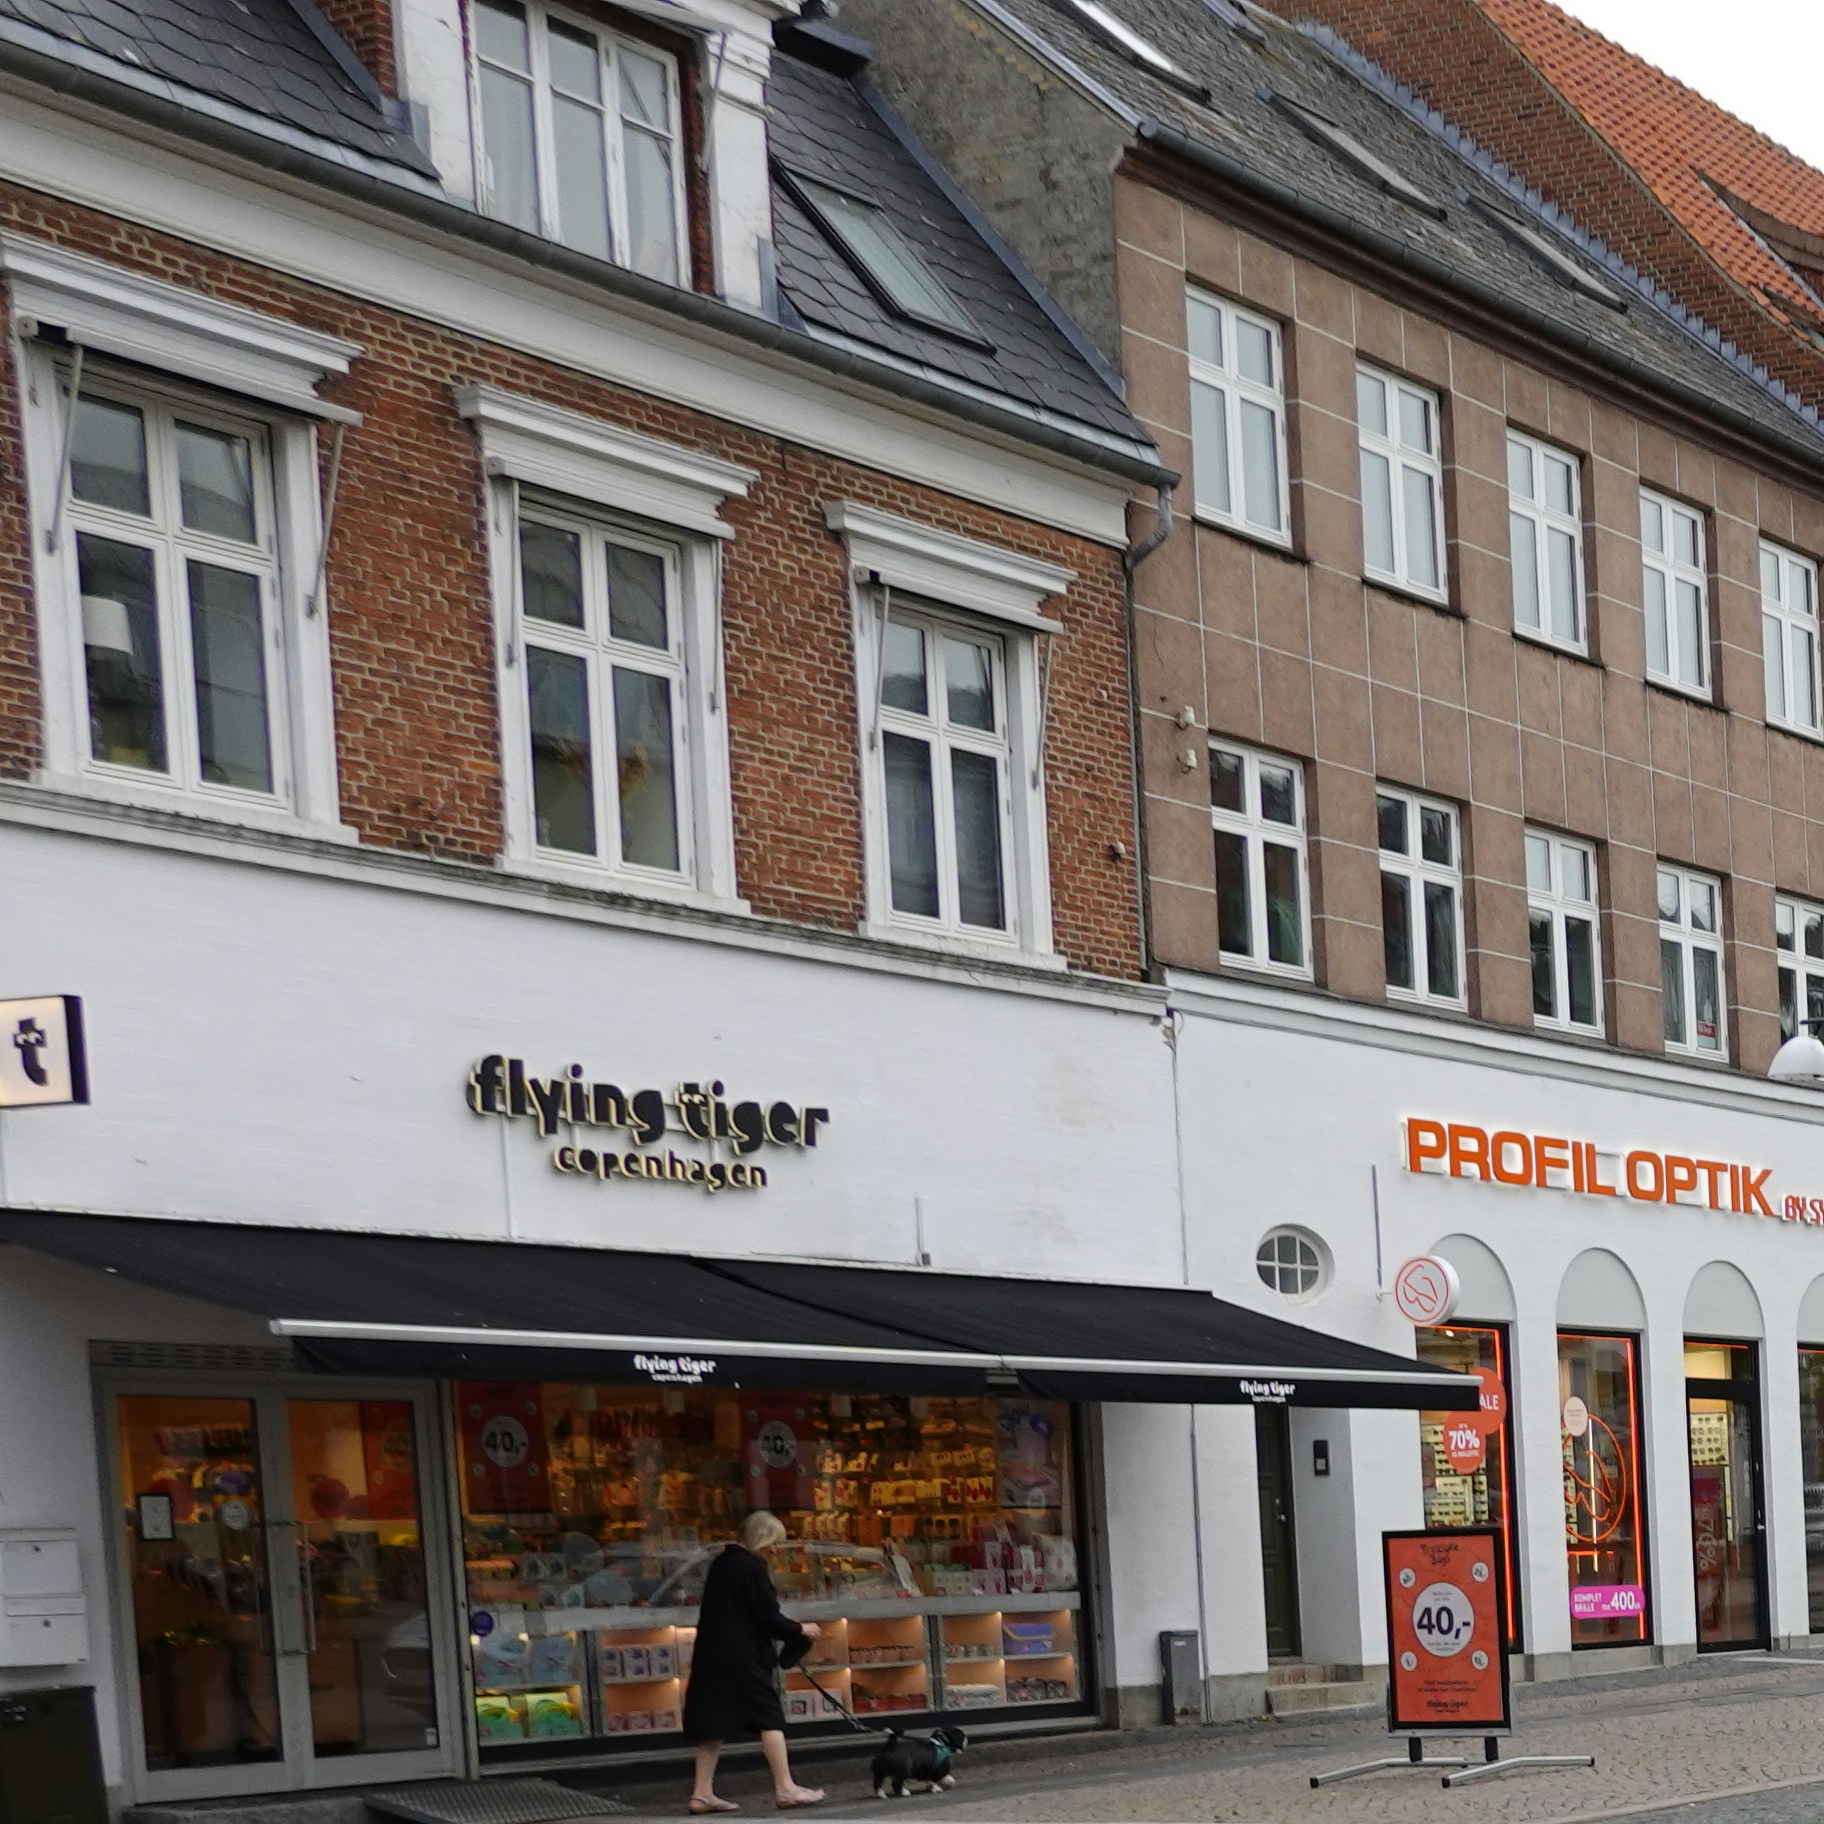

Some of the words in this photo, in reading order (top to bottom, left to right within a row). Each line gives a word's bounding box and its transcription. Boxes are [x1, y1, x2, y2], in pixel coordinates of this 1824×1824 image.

[467, 1054, 666, 1146] flying
[674, 1079, 830, 1156] tiger
[553, 1146, 768, 1192] copenhagen
[1407, 1117, 1617, 1196] PROFIL
[1626, 1150, 1774, 1216] OPTIK
[1479, 1393, 1500, 1410] ALE
[1448, 1428, 1481, 1450] 70%
[1611, 1590, 1635, 1610] 400
[1417, 1606, 1471, 1640] 40,-
